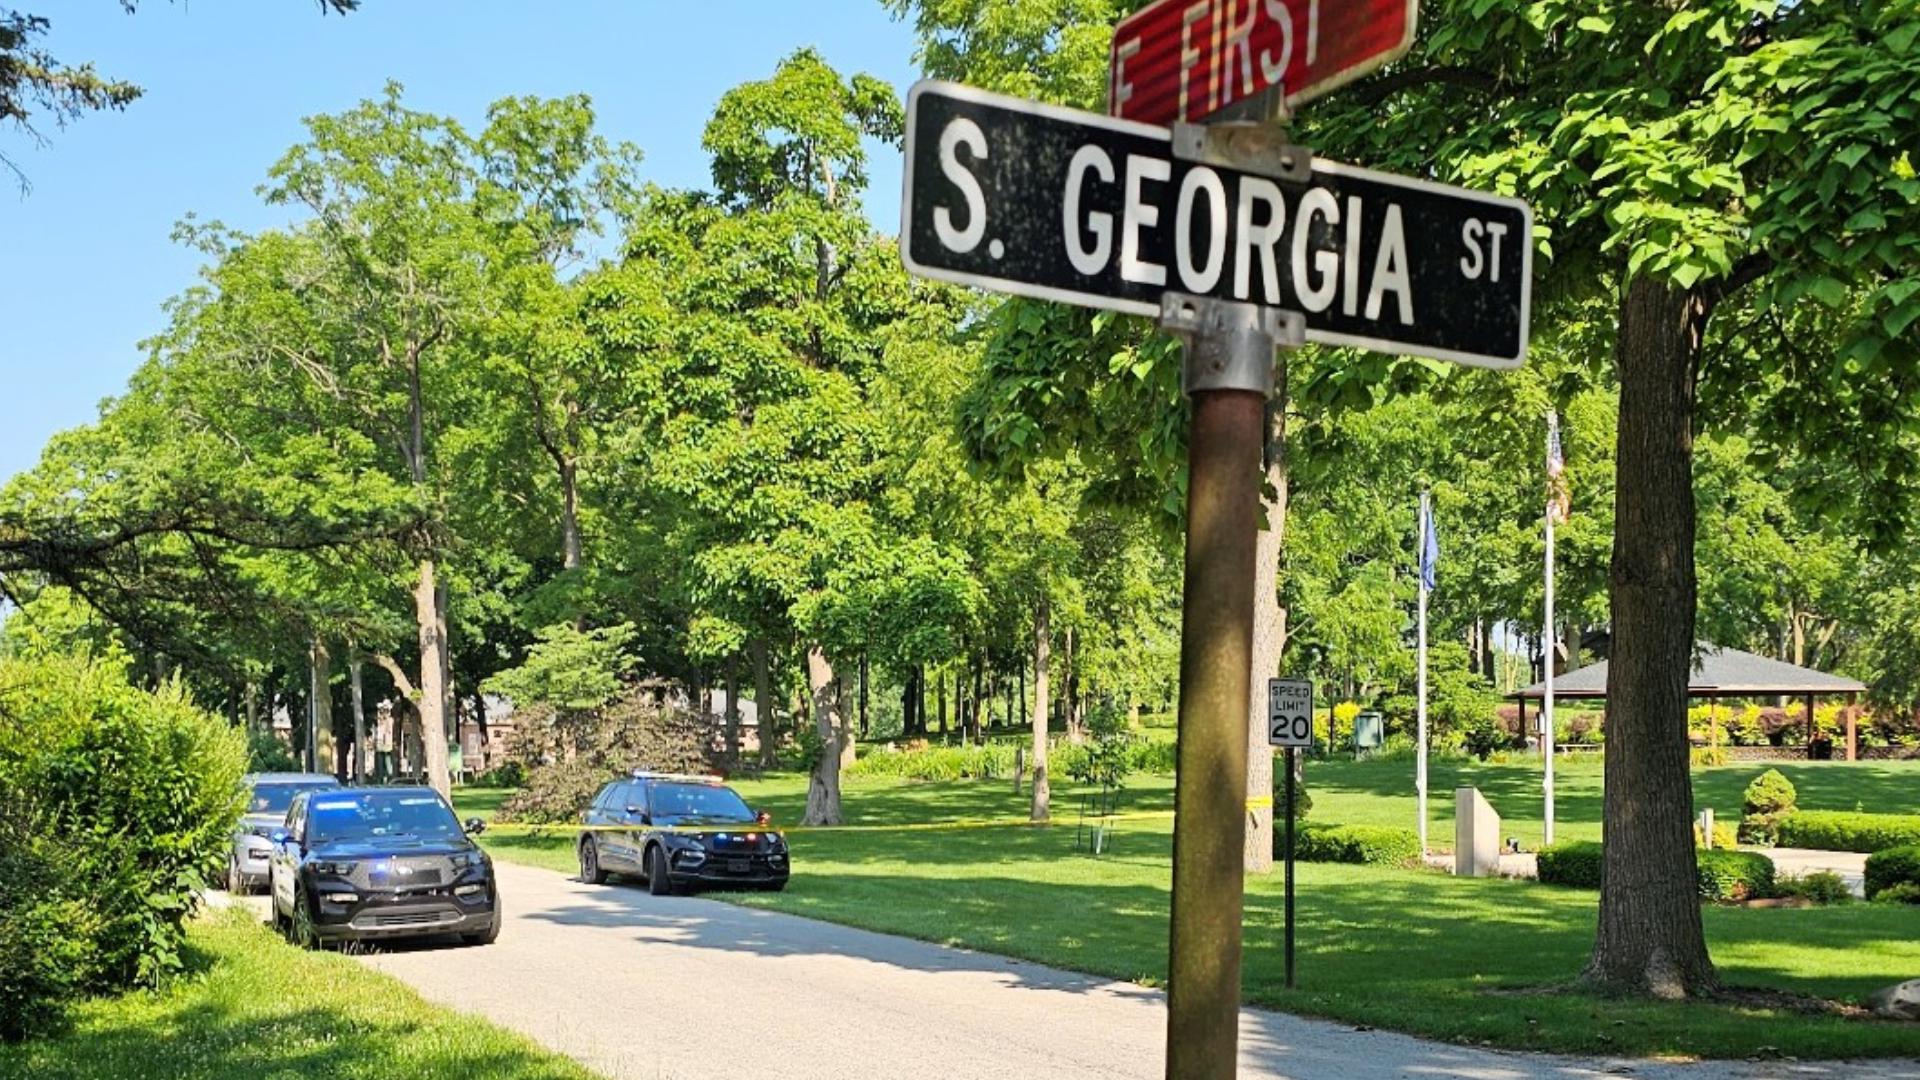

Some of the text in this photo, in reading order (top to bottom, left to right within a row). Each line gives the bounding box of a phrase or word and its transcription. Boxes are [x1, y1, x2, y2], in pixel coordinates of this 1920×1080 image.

[1178, 0, 1319, 123] FIRST
[933, 117, 1508, 326] S. GEORGIA ST
[1272, 686, 1310, 698] SPEED
[1275, 700, 1305, 711] LIMIT
[1272, 714, 1309, 740] 20
